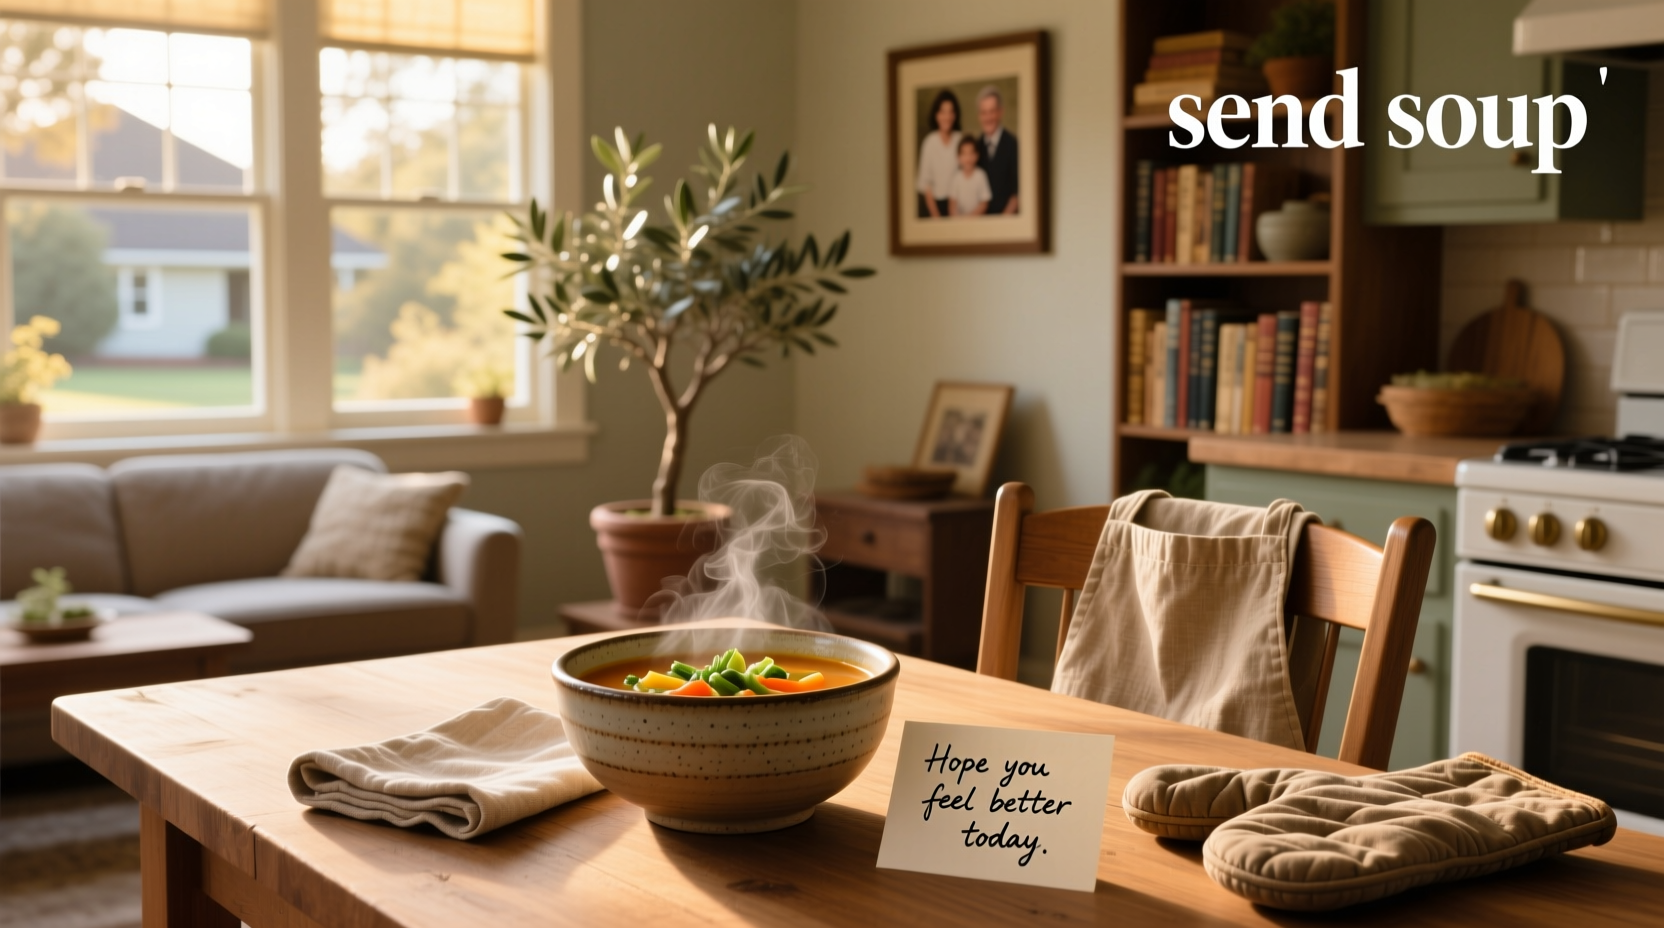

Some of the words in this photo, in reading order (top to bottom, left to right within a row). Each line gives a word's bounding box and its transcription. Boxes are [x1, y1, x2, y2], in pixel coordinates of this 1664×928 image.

[924, 743, 989, 785] Hope
[999, 760, 1050, 787] you
[921, 783, 976, 821] feel
[989, 788, 1072, 815] better
[961, 820, 1048, 867] today.
